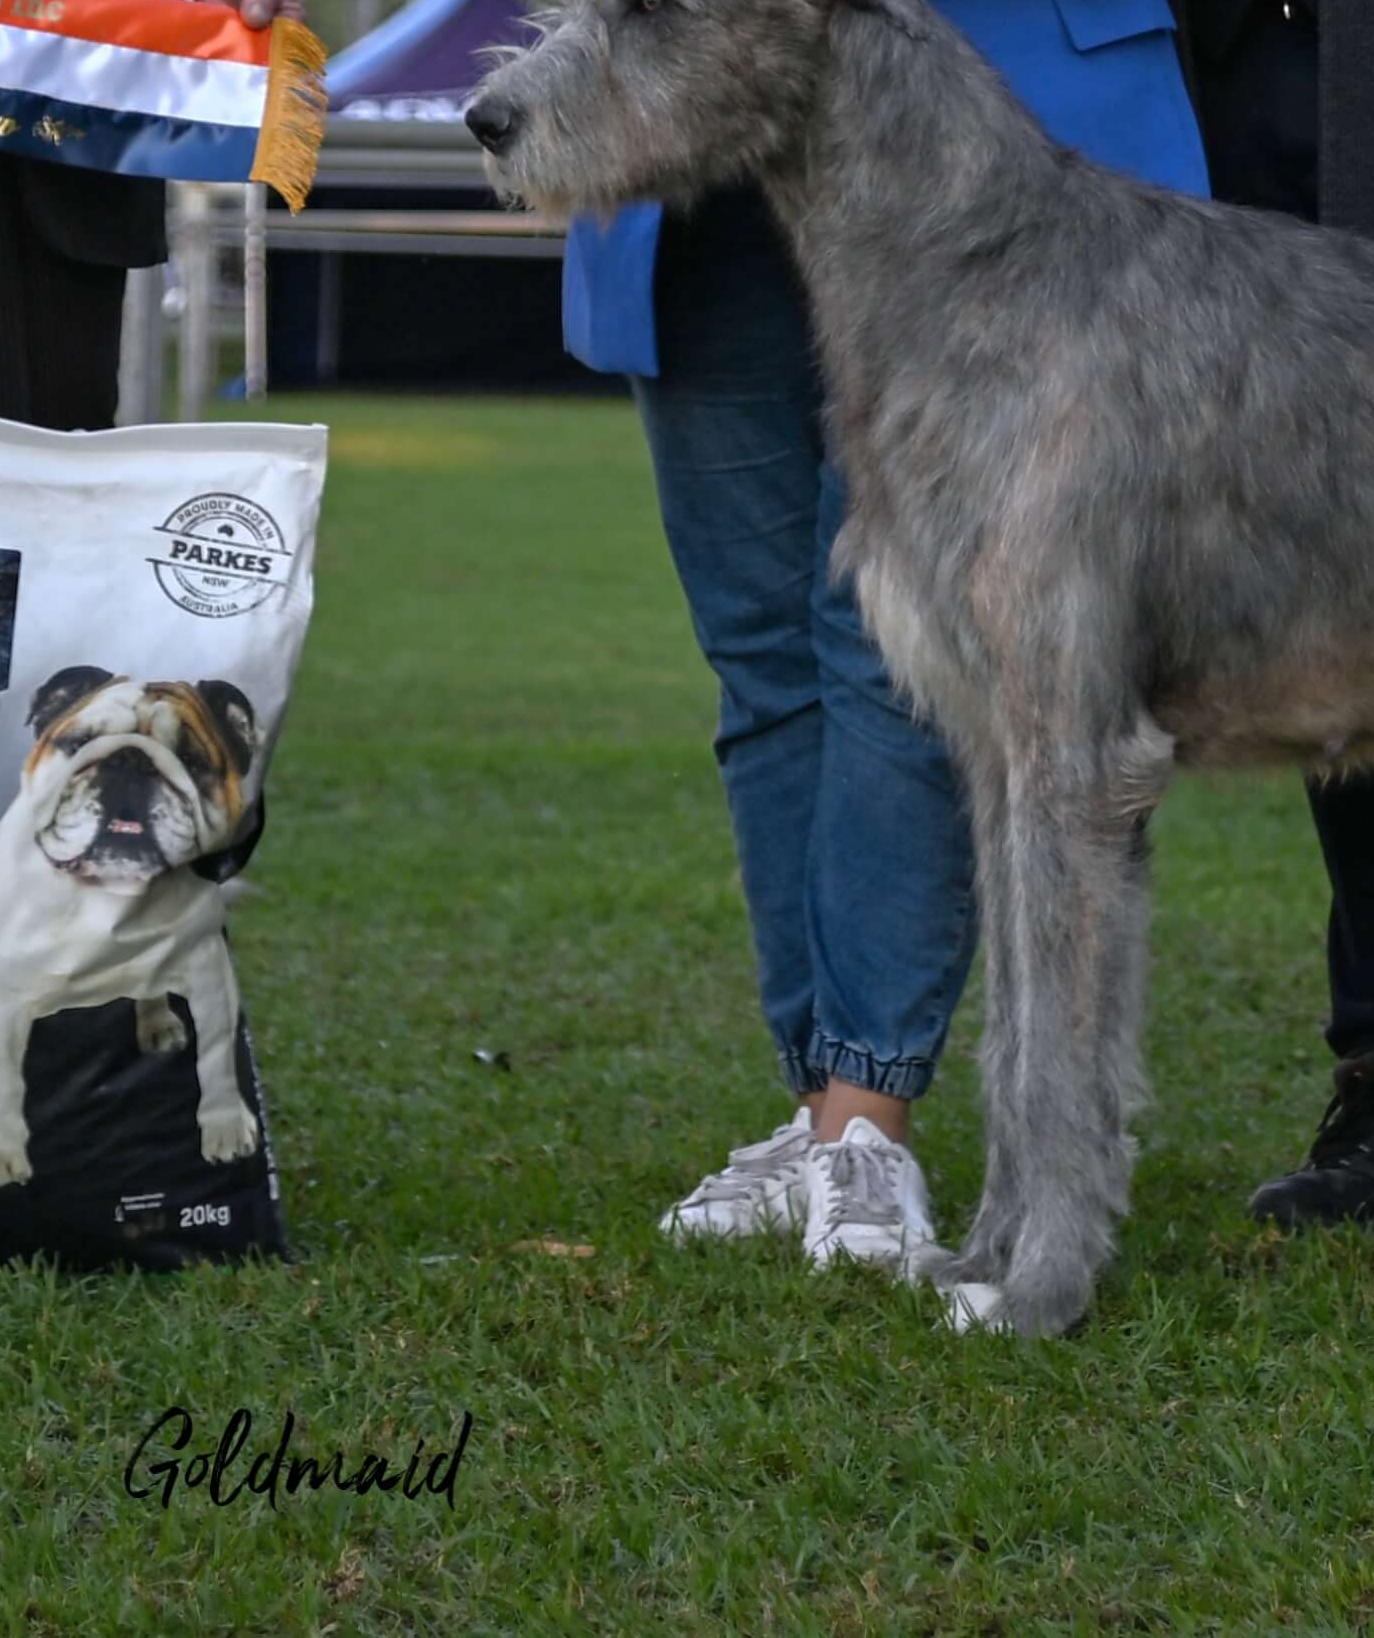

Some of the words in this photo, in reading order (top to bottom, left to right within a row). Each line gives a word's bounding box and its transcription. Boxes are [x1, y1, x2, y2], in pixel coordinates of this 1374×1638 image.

[177, 500, 232, 523] PROUDLY
[235, 504, 265, 528] MADE
[264, 525, 275, 540] IN
[169, 539, 273, 575] PARKES
[202, 576, 230, 587] NSW
[179, 595, 238, 613] AUSTRALIA
[180, 1204, 231, 1228] 20kg
